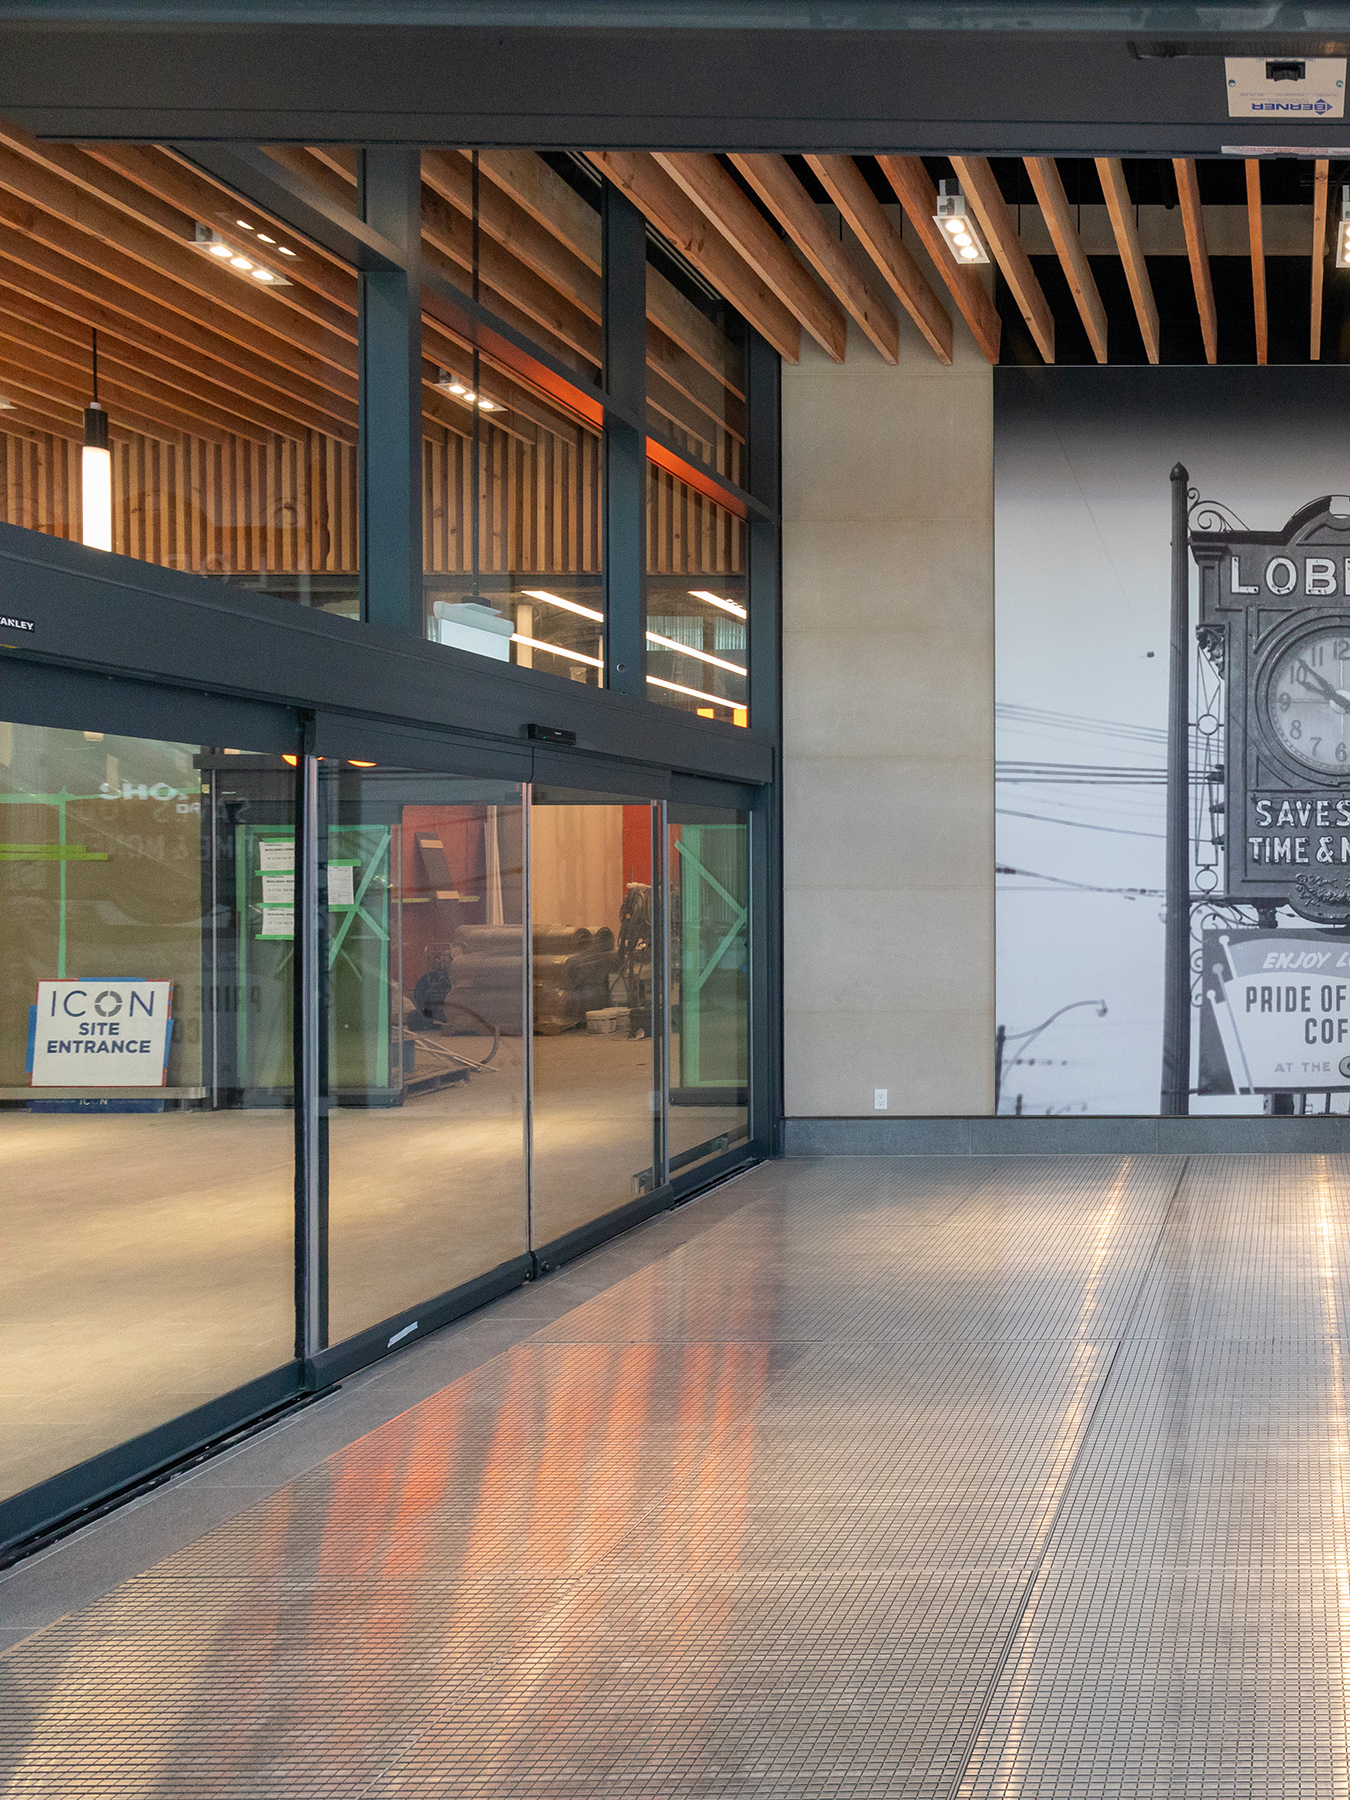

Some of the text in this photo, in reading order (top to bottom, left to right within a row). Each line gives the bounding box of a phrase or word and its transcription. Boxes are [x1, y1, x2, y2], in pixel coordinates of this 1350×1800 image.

[1251, 103, 1326, 111] BERNER
[0, 616, 34, 630] ANLEY
[1312, 646, 1323, 667] 11
[1333, 640, 1350, 661] 12
[1279, 692, 1291, 712] 9
[1290, 720, 1302, 740] 8
[1310, 737, 1322, 757] 7
[1335, 743, 1348, 762] 6
[1249, 836, 1309, 863] TIME
[1316, 836, 1334, 863] &
[1262, 952, 1331, 969] ENJOY
[51, 990, 155, 1018] ICON
[1245, 986, 1311, 1013] PRIDE
[1320, 984, 1347, 1012] OF
[78, 1022, 120, 1036] SITE
[47, 1040, 151, 1054] ENTRANCE
[1274, 1063, 1294, 1074] AT
[1301, 1062, 1331, 1073] THE
